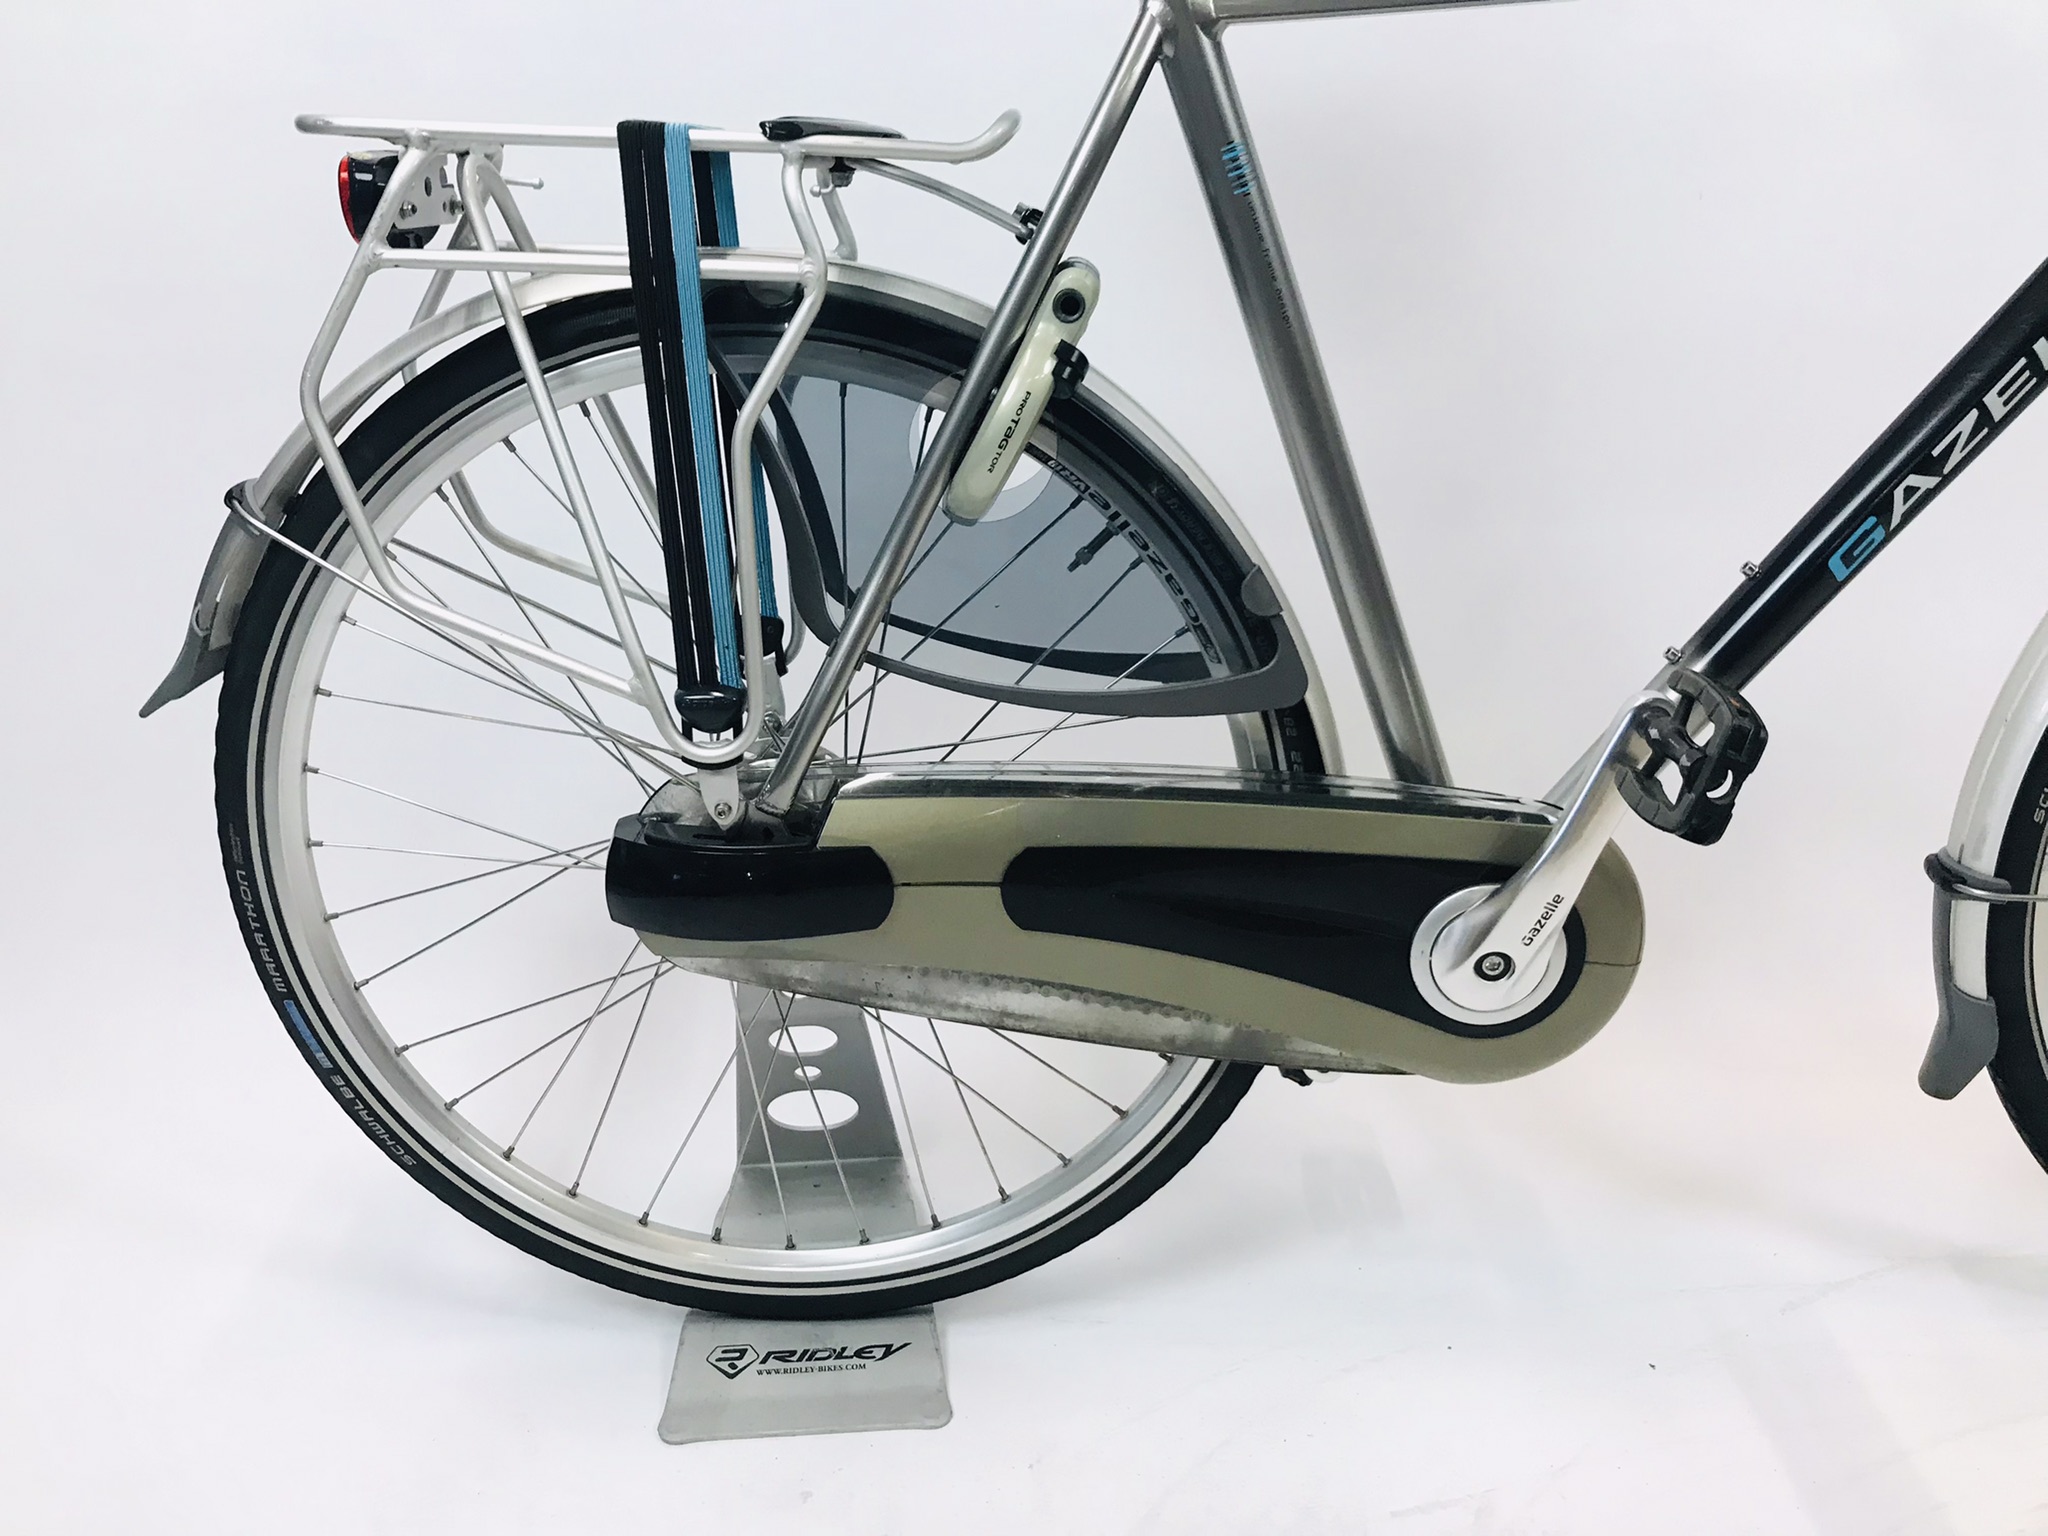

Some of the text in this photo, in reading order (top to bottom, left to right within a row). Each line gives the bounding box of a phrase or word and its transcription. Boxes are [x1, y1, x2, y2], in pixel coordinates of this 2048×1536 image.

[1089, 488, 1200, 625] Gazelle
[2033, 787, 2048, 824] SC
[236, 869, 287, 993] MARATHON
[1520, 893, 1564, 947] Gazelle
[330, 1074, 417, 1167] SCHWALBE
[756, 1363, 867, 1376] WWW.RIDLEY-BIKES.COM
[758, 1342, 912, 1365] RIDLEY
